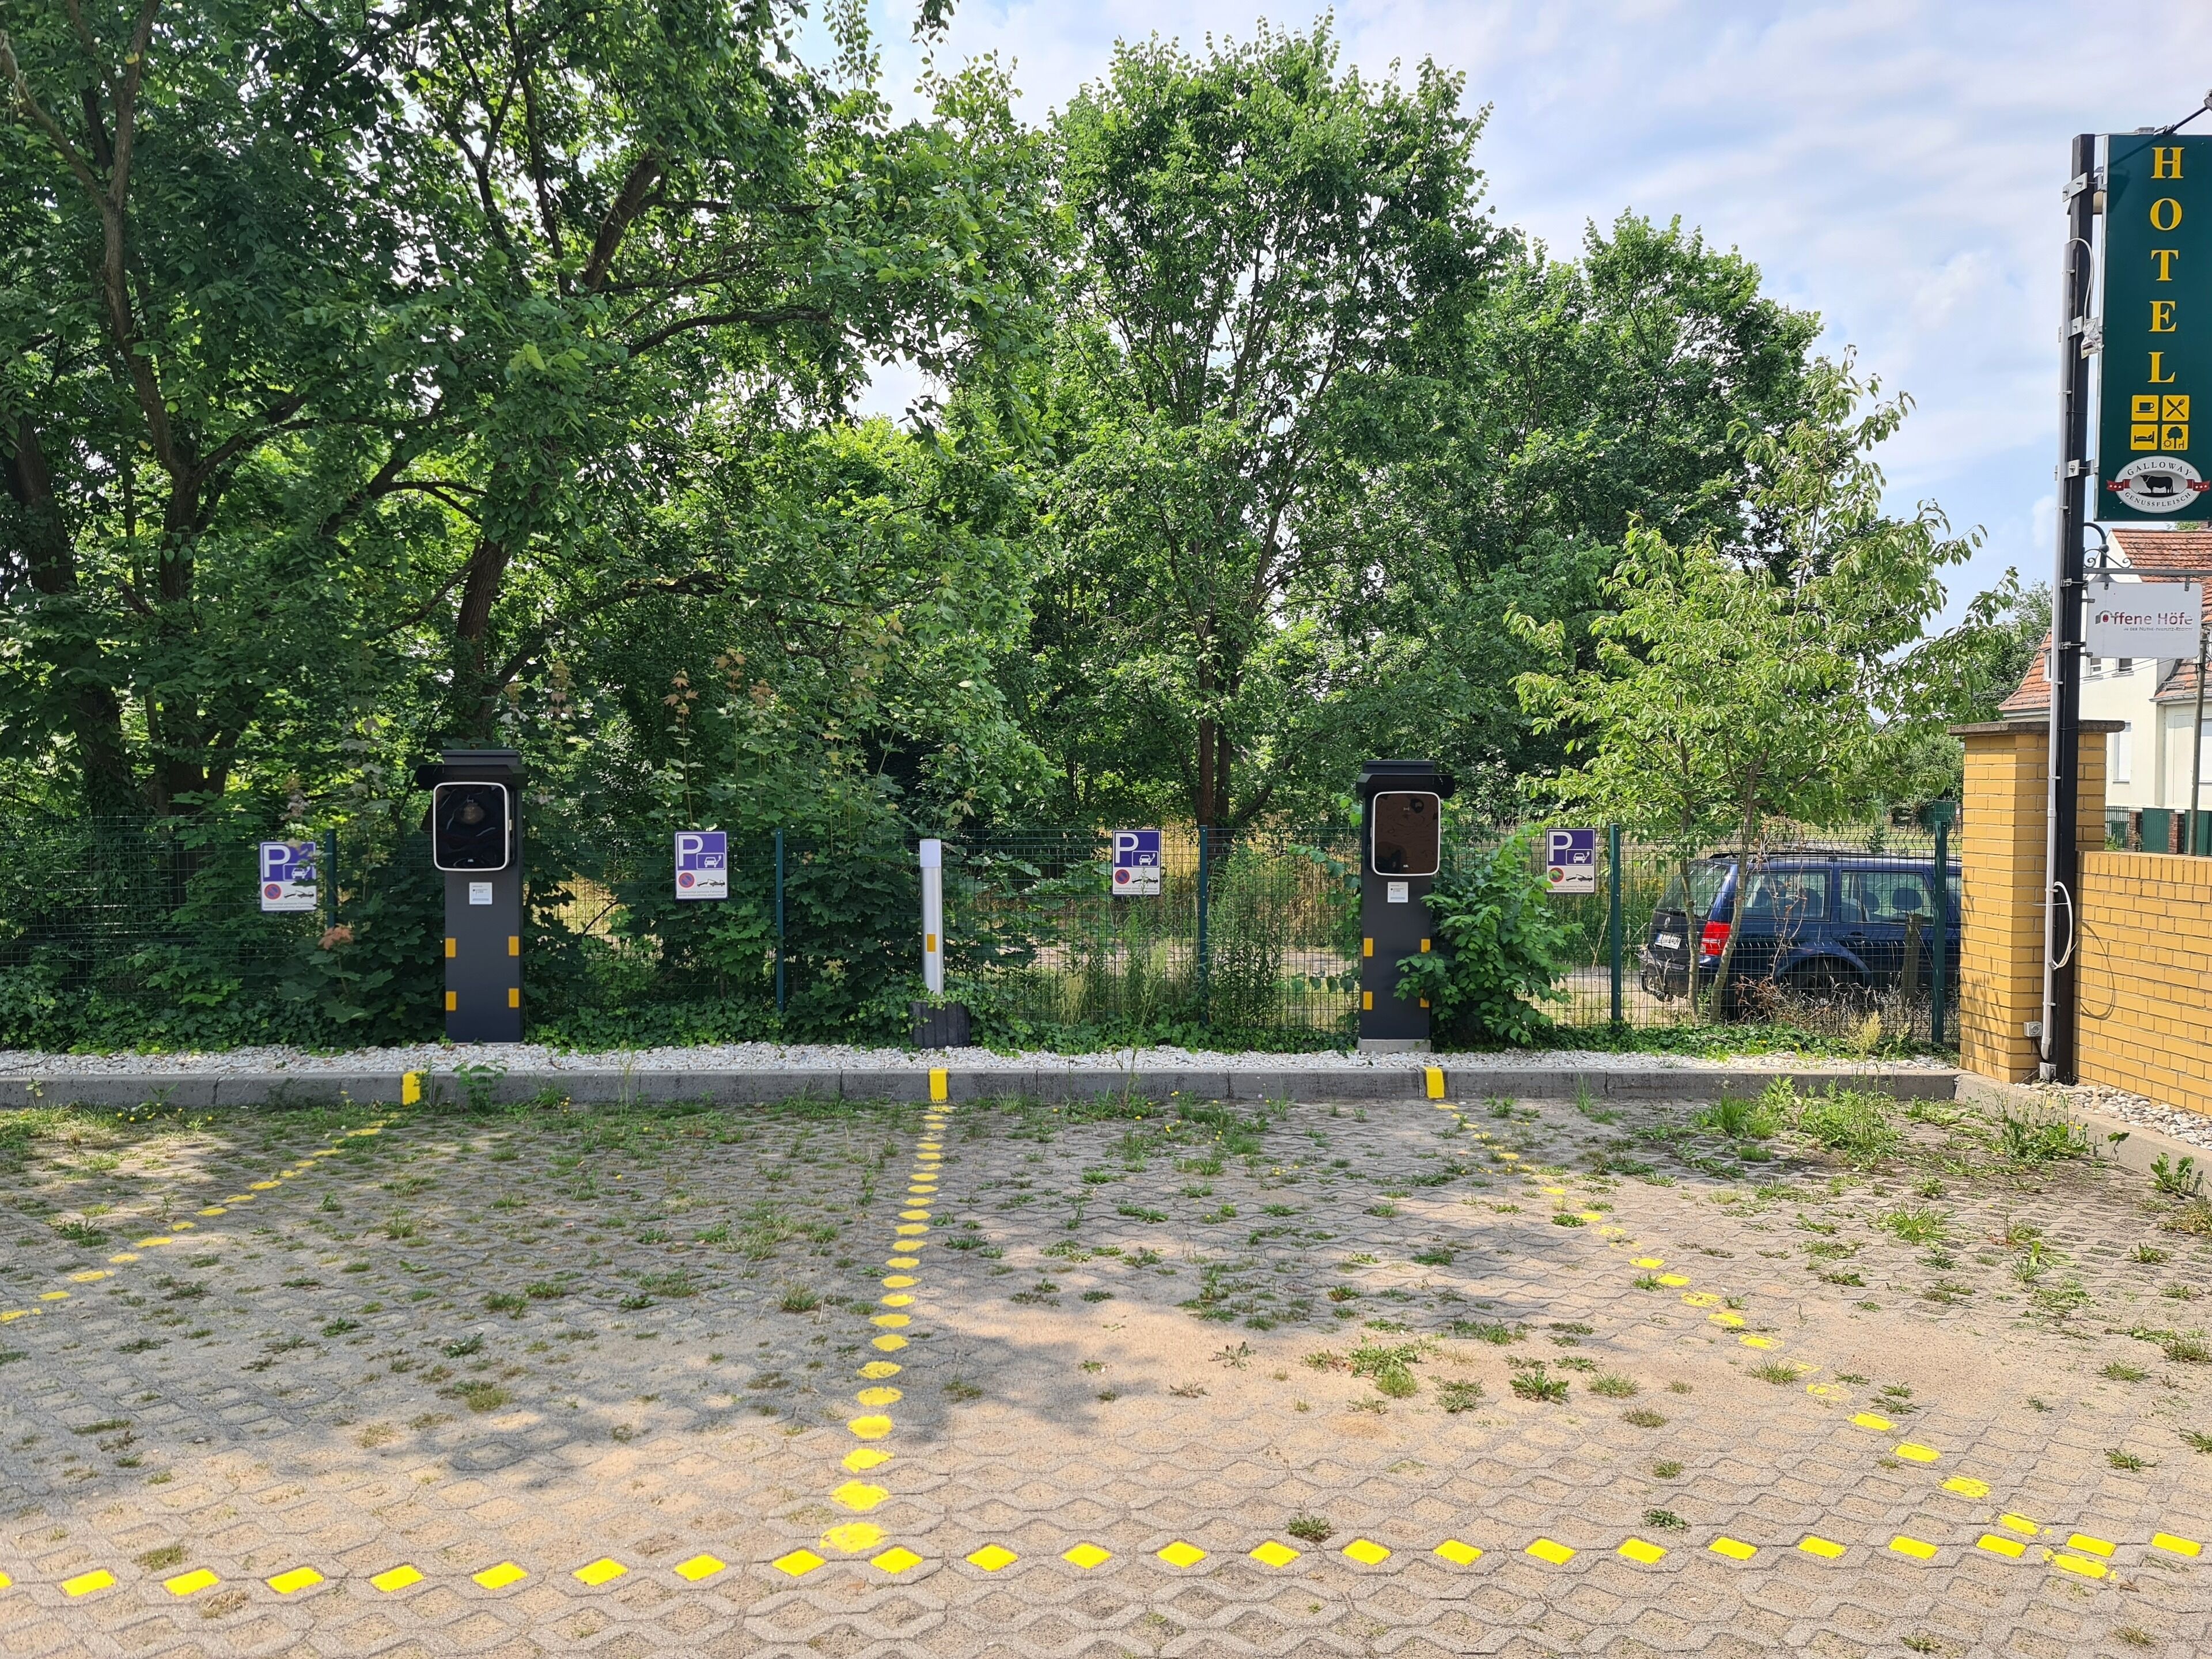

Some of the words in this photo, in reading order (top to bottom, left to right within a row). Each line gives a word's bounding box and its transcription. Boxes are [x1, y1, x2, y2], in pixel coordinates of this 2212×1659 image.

[2147, 146, 2185, 383] HOTEL
[2127, 461, 2192, 476] GALLOWAY
[2124, 491, 2191, 507] GENUSSFLEISCH
[2158, 612, 2193, 625] Höfe
[263, 844, 291, 878] P
[678, 835, 703, 866] P
[1115, 833, 1139, 863] P
[1549, 831, 1573, 862] P
